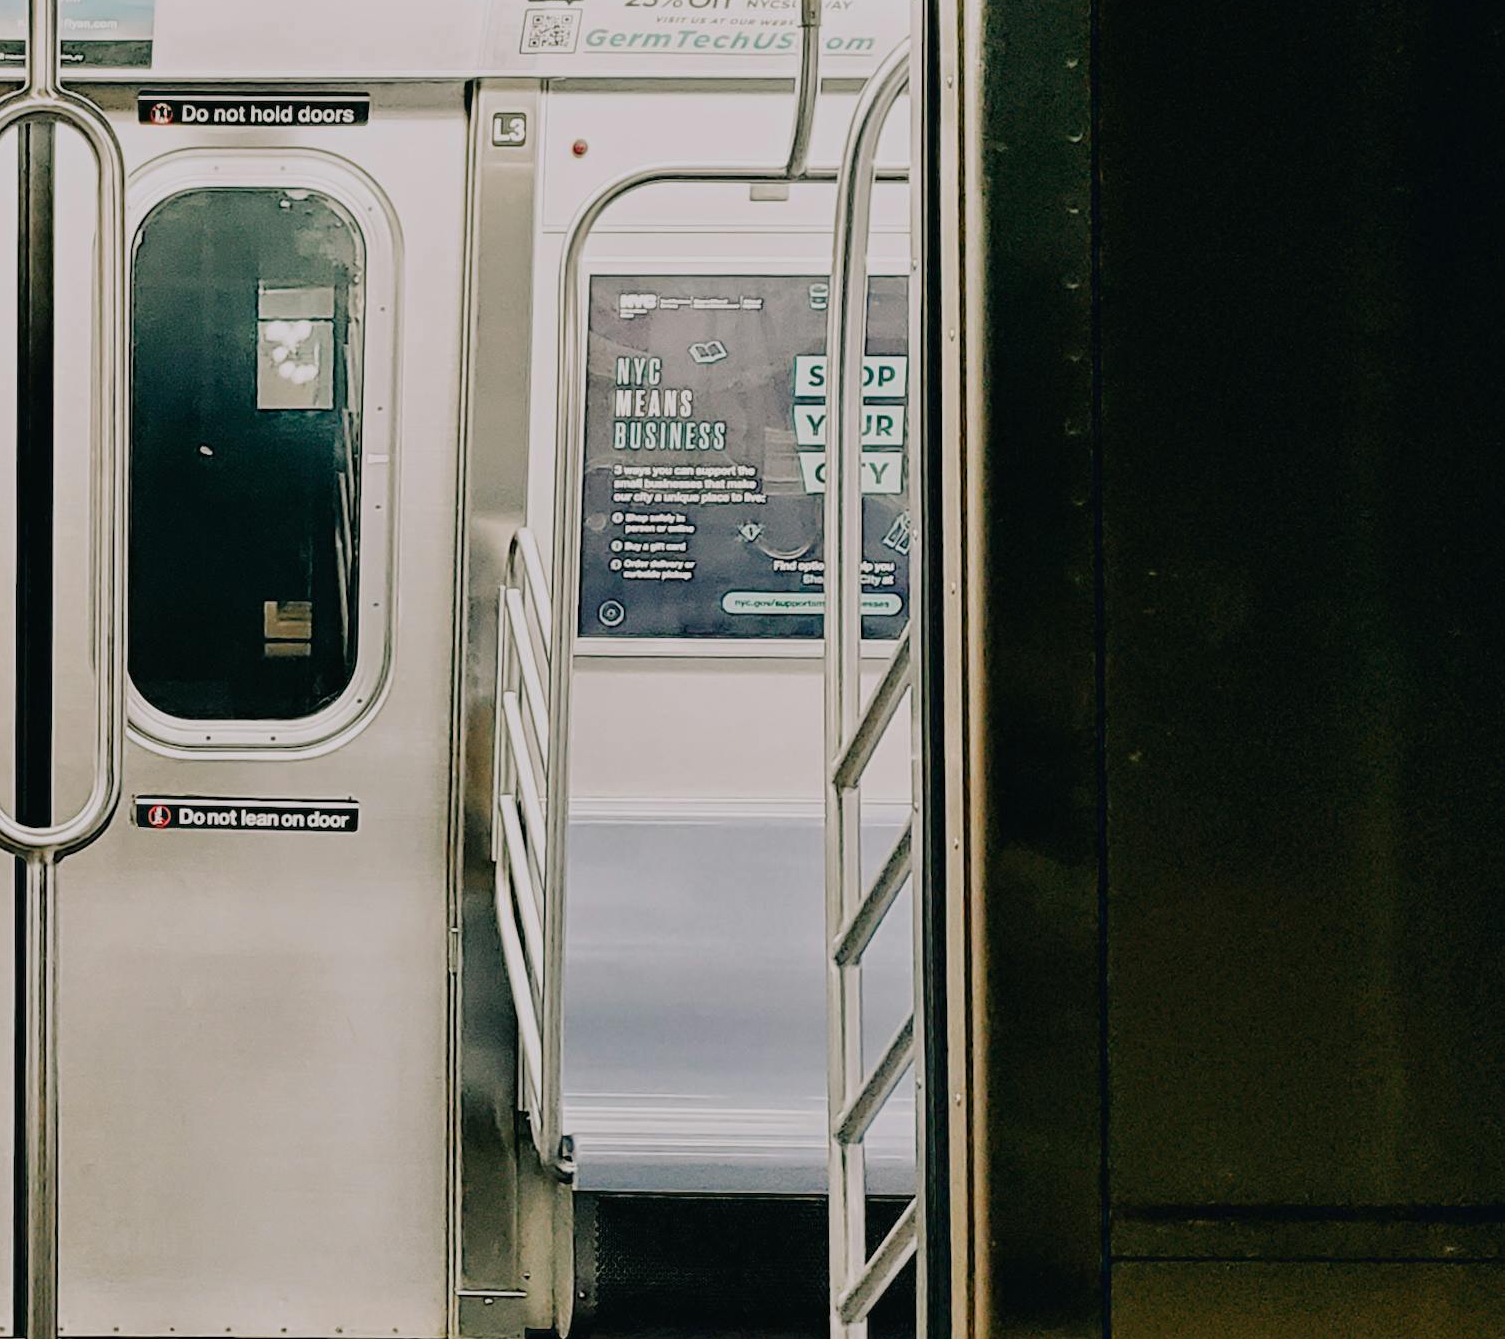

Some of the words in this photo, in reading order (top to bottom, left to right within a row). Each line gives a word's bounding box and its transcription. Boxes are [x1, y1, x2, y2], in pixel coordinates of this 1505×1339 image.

[746, 0, 855, 10] NYCSAY
[585, 28, 876, 51] GermTechUSom
[181, 104, 209, 123] Do
[213, 105, 246, 123] not
[250, 104, 293, 123] hold
[297, 105, 355, 124] doors
[493, 117, 526, 142] L3
[616, 356, 662, 386] NYC
[808, 365, 896, 387] SOP
[614, 389, 694, 418] MEANS
[613, 421, 726, 451] BUSINESS
[806, 414, 894, 437] YUR
[623, 466, 651, 477] ways
[652, 467, 673, 477] you
[674, 466, 694, 476] can
[696, 466, 736, 477] support
[737, 466, 756, 476] the
[815, 463, 890, 485] CY
[704, 479, 726, 489] that
[613, 493, 633, 503] our
[633, 492, 654, 504] city
[663, 492, 700, 504] unique
[701, 492, 730, 504] place
[731, 493, 743, 503] to
[773, 560, 797, 572] Find
[178, 808, 206, 825] Do
[206, 809, 238, 826] not
[240, 809, 279, 827] lean
[280, 812, 305, 827] on
[307, 811, 349, 828] door
